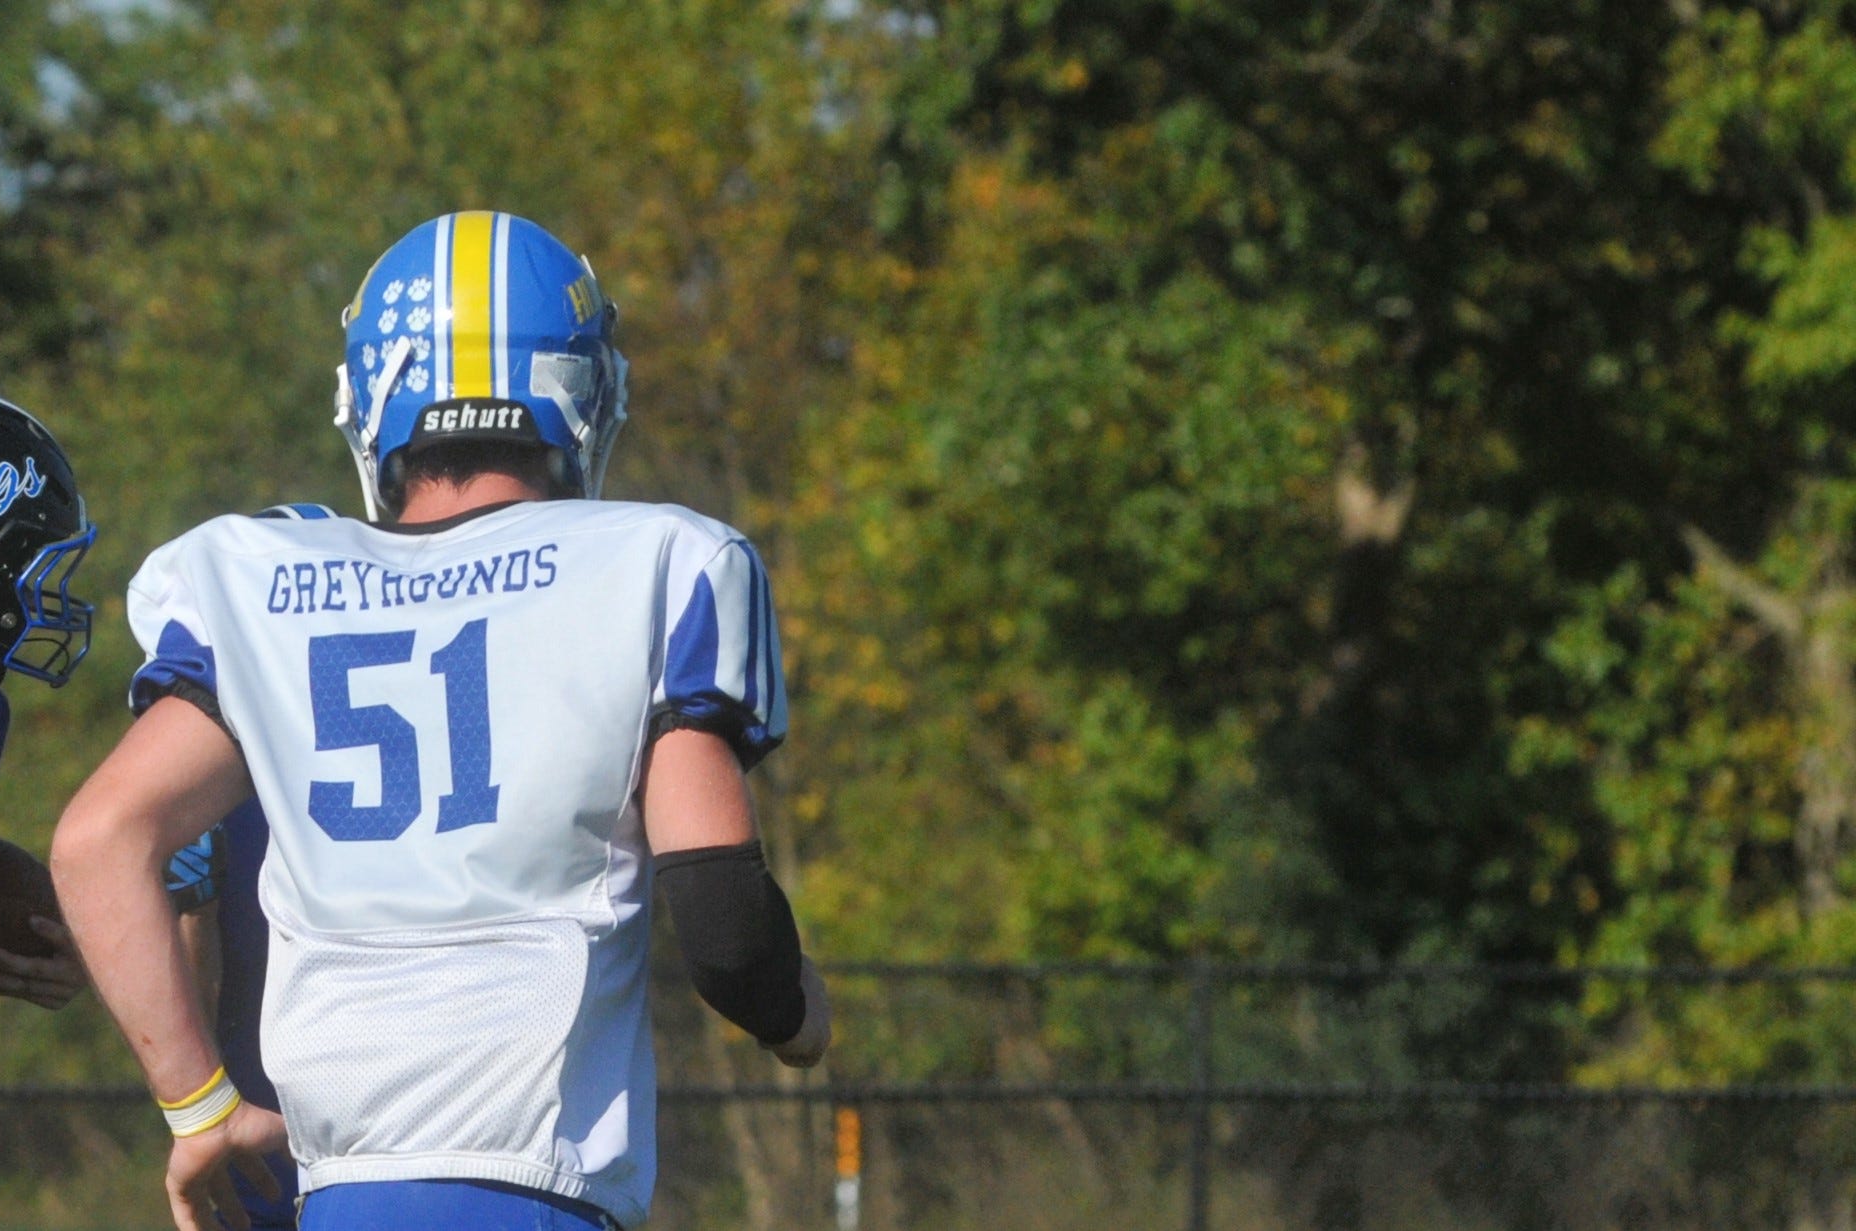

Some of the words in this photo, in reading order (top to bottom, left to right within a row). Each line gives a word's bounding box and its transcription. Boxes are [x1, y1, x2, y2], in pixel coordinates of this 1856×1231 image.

[424, 403, 523, 431] schutt
[267, 543, 558, 614] GREYHOUNDS
[308, 617, 501, 842] 51
